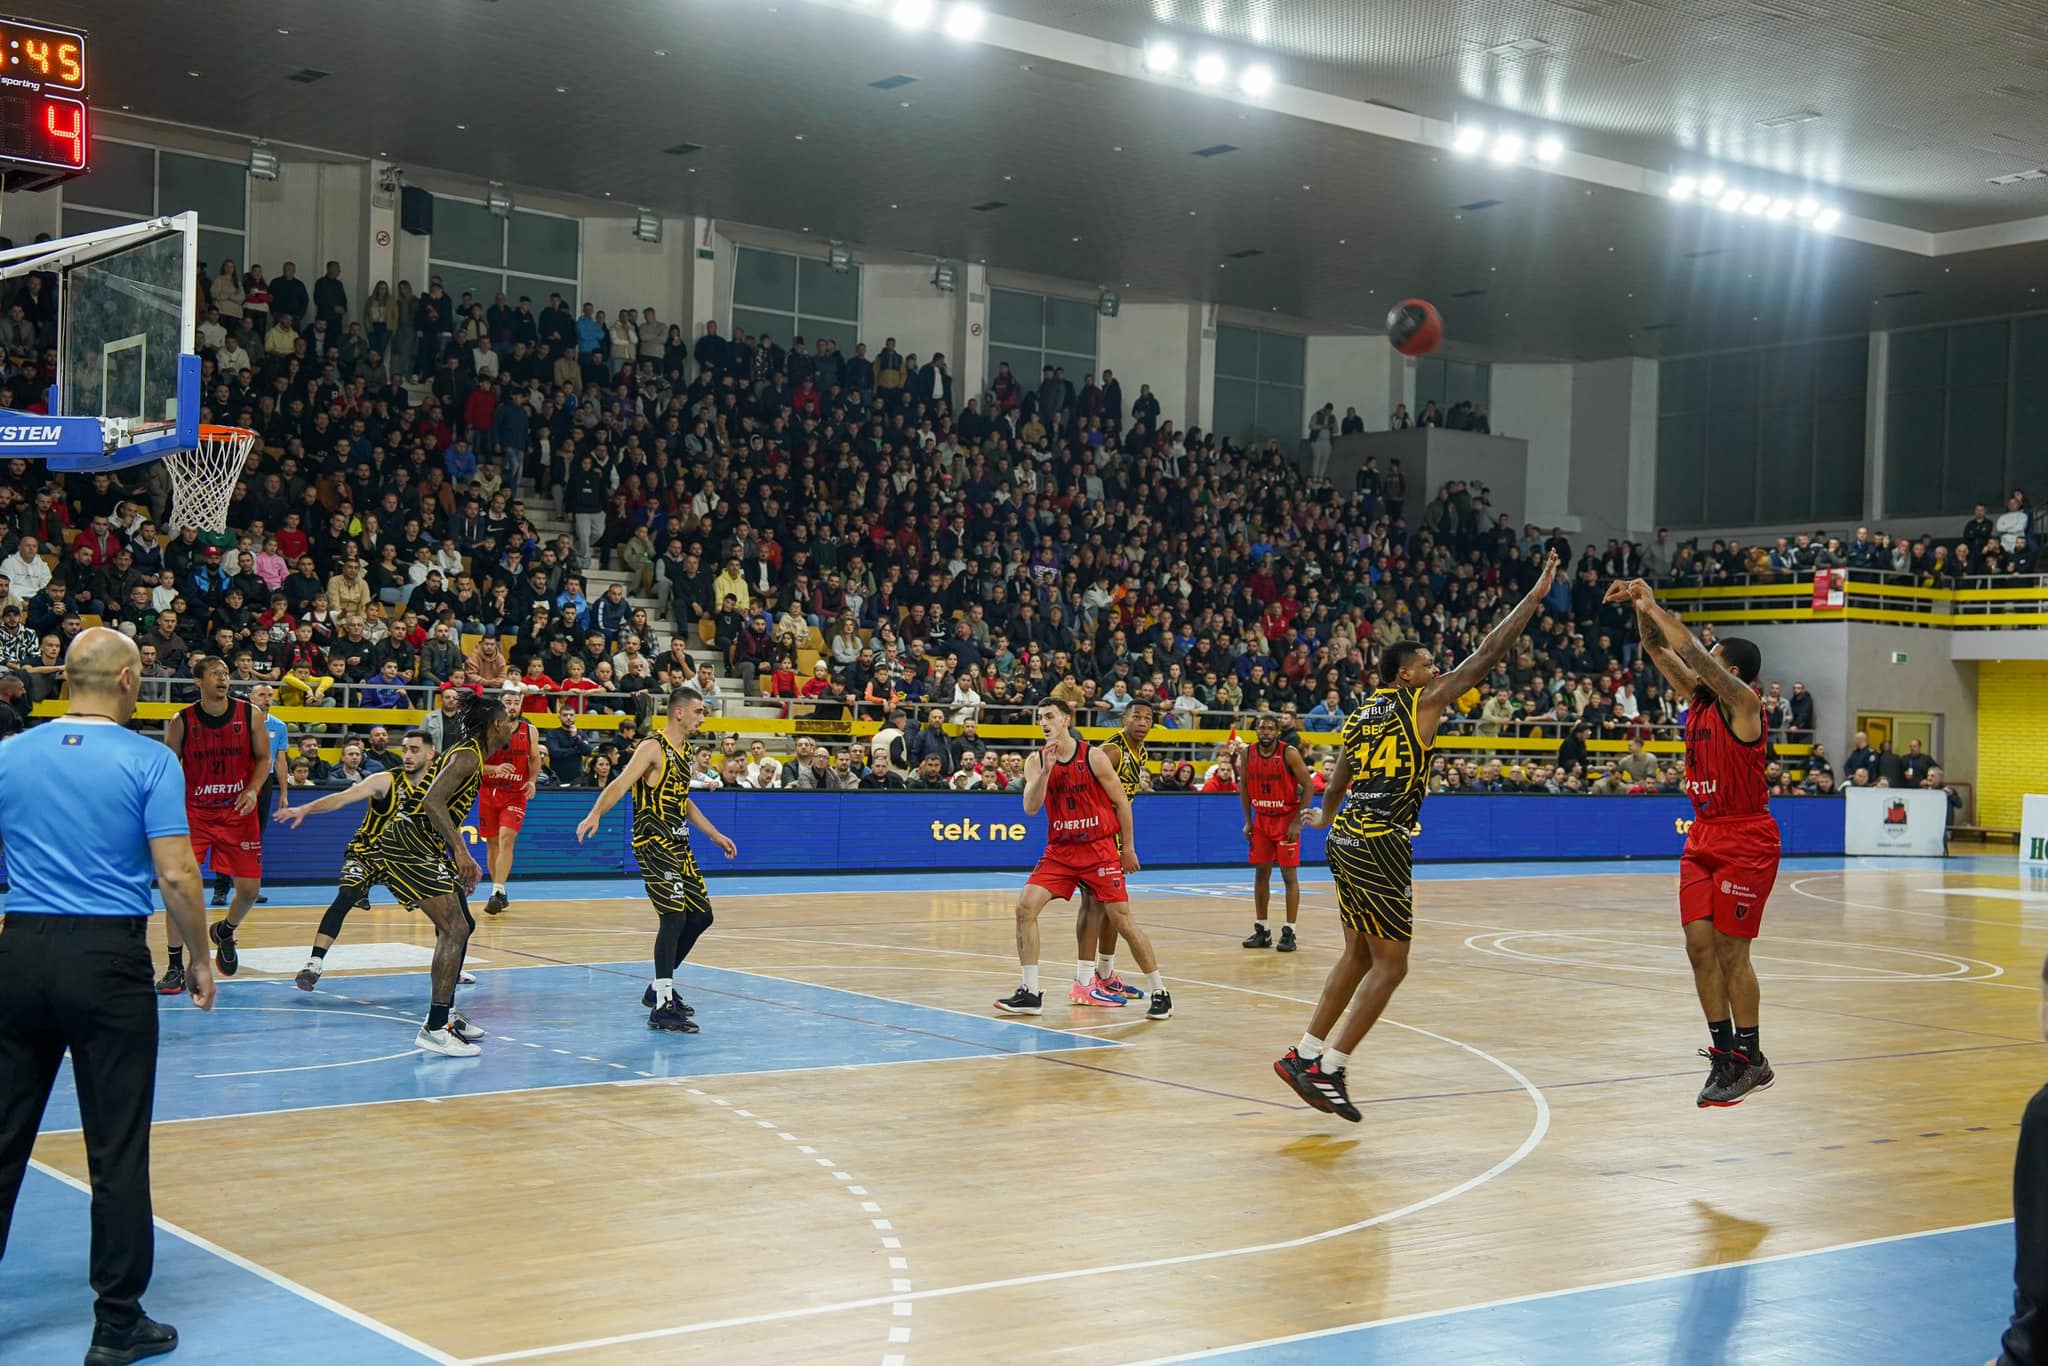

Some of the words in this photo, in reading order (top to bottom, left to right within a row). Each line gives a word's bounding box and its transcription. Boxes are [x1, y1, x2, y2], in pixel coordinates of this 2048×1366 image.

[0, 38, 80, 81] :45
[1, 76, 41, 92] sporting
[48, 105, 81, 162] 4
[1353, 735, 1402, 780] 14
[931, 818, 981, 841] tek
[989, 823, 1026, 841] ne
